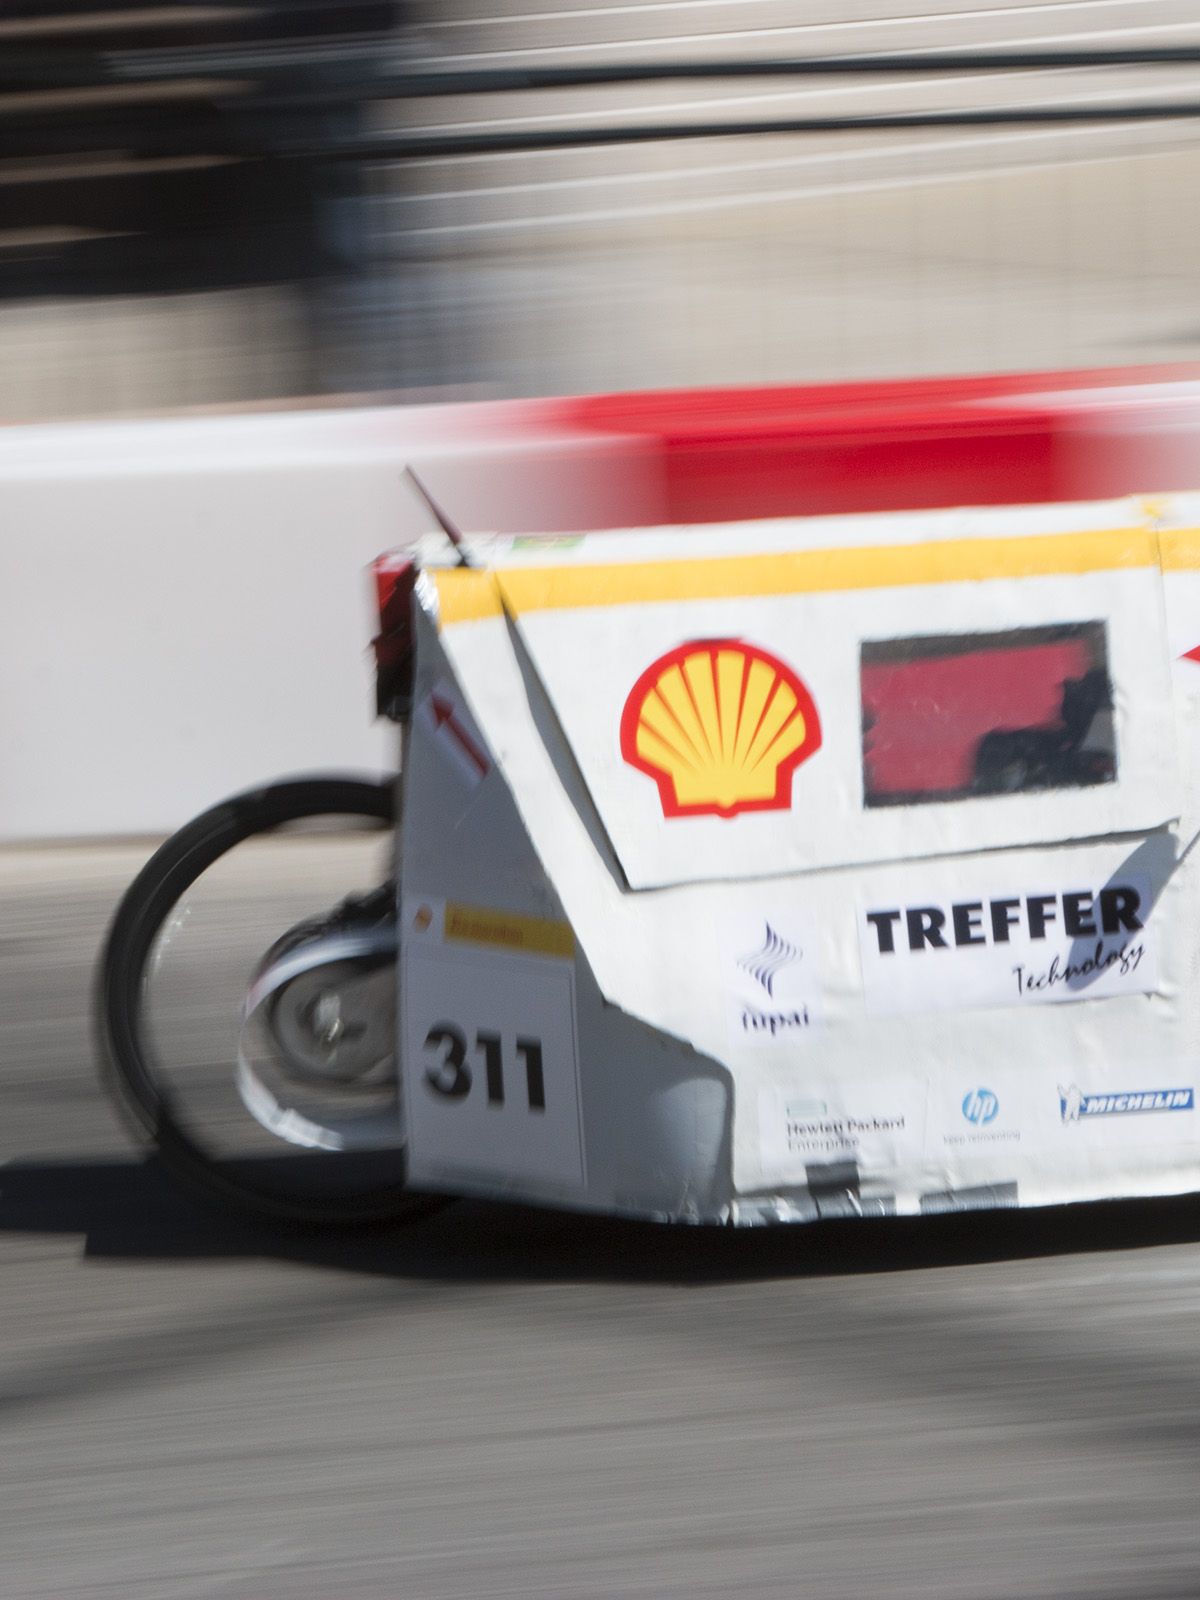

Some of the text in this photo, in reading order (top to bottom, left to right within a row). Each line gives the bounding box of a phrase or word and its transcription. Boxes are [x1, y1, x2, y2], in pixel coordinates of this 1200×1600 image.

[866, 885, 1144, 955] TREFFER
[1012, 941, 1145, 996] Technology
[422, 1019, 546, 1117] 311
[1086, 1090, 1190, 1114] MICHELIN
